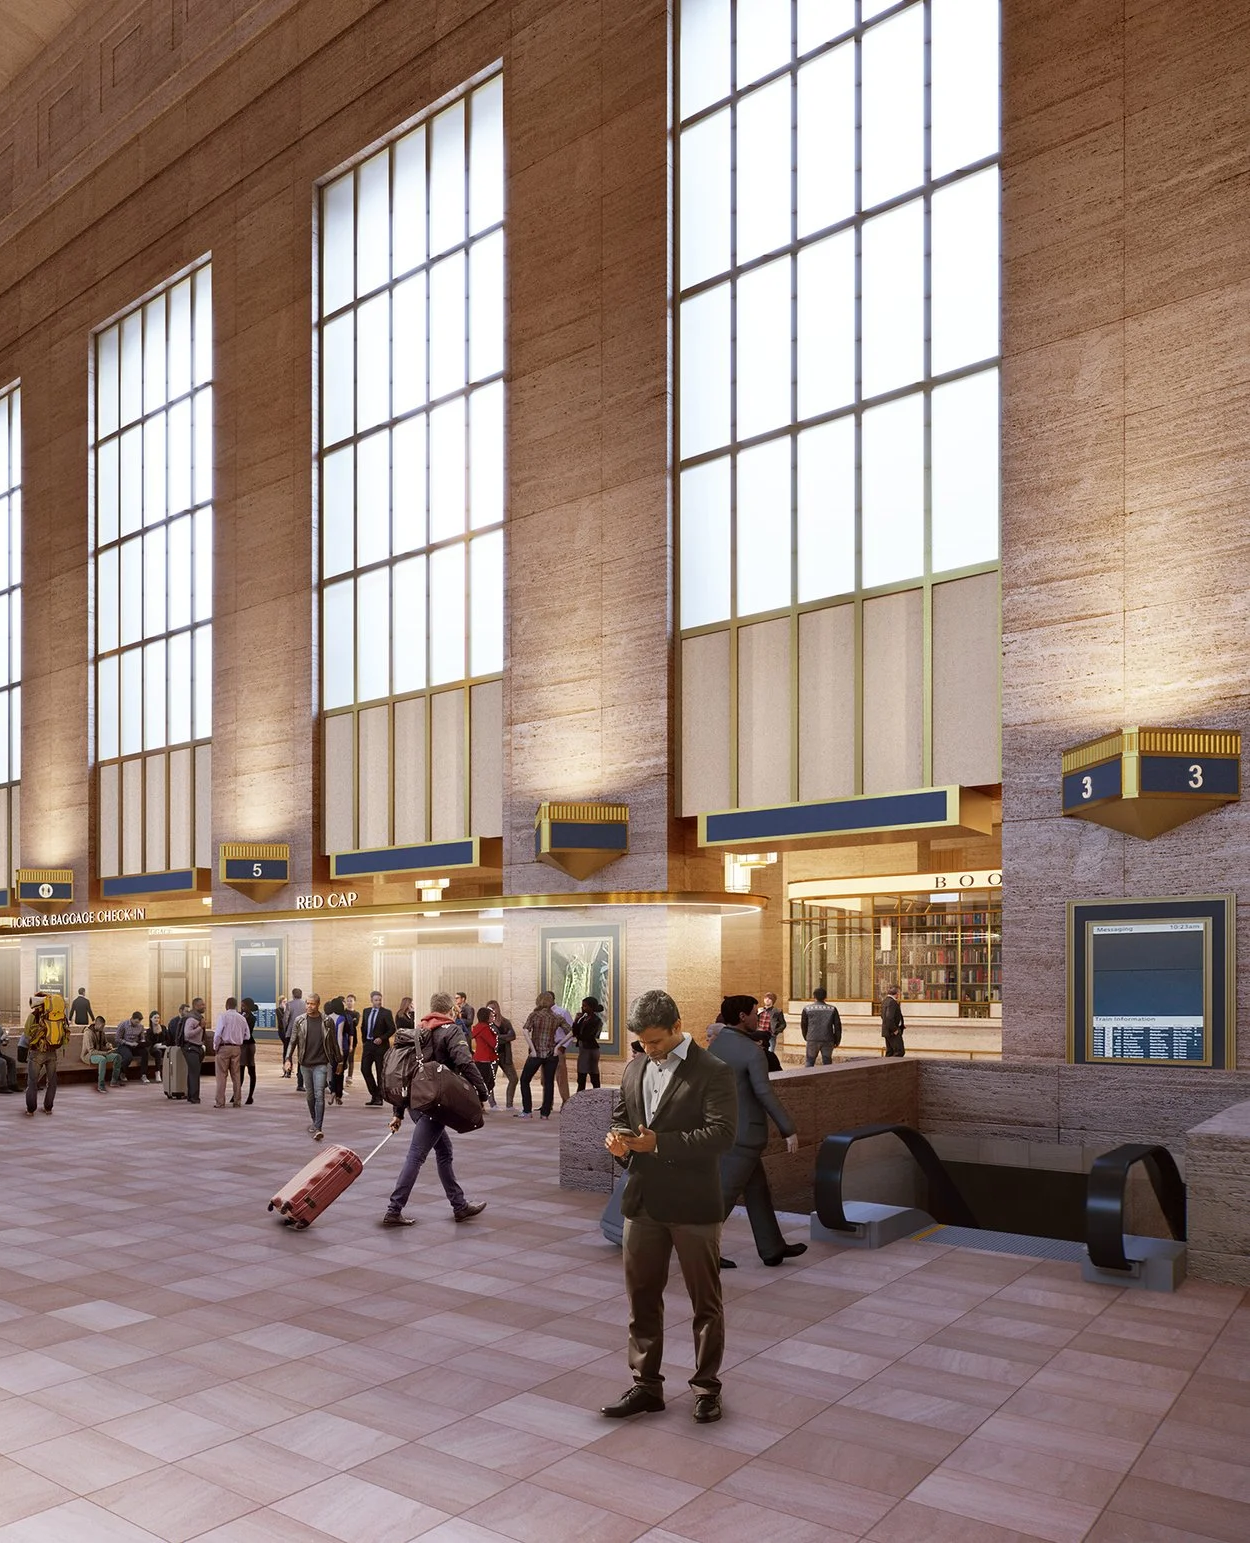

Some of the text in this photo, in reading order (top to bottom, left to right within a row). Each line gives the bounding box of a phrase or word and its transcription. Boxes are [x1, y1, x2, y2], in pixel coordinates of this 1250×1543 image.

[1188, 765, 1204, 788] 3
[1082, 776, 1092, 799] 3
[252, 863, 262, 877] 5
[296, 892, 358, 909] RED CAP
[11, 908, 146, 928] TICKETS & BAGGAGE CHECK-IN
